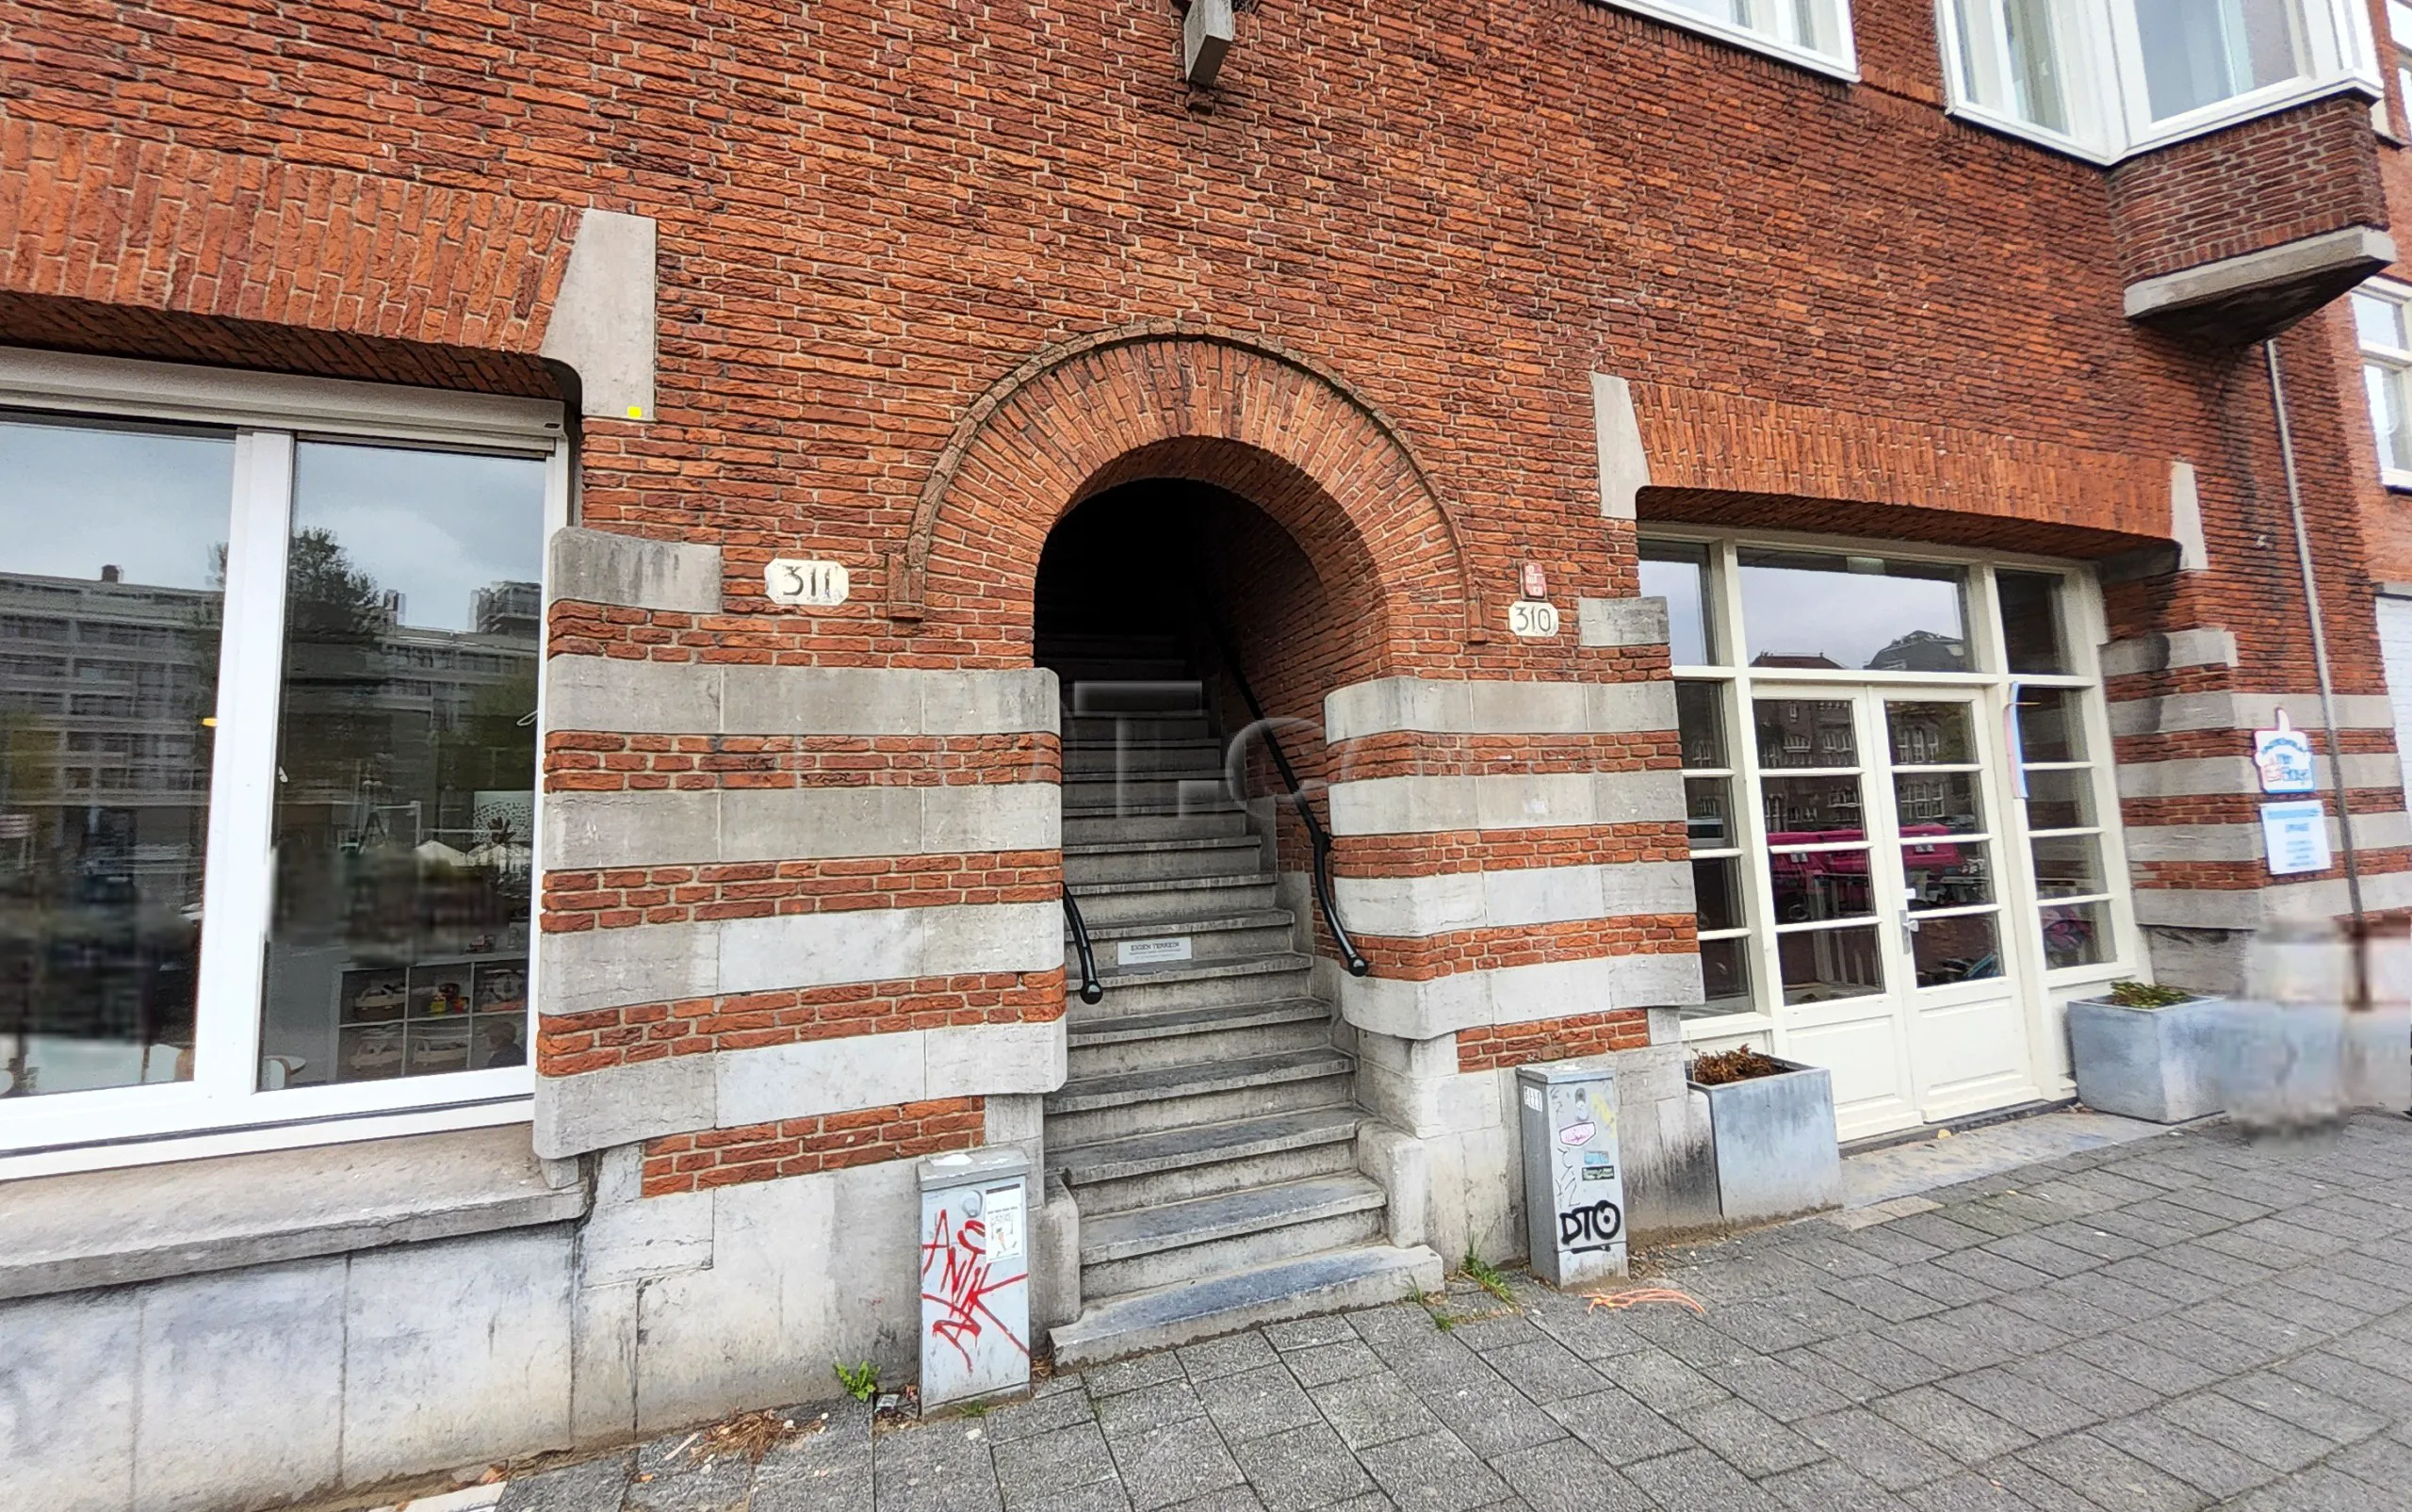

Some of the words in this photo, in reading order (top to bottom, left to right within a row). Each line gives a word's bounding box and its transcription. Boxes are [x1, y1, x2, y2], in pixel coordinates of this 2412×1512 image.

[782, 564, 831, 598] 311
[1514, 606, 1552, 633] 310
[1131, 943, 1151, 951] EIGEN
[1559, 1199, 1621, 1245] DTO
